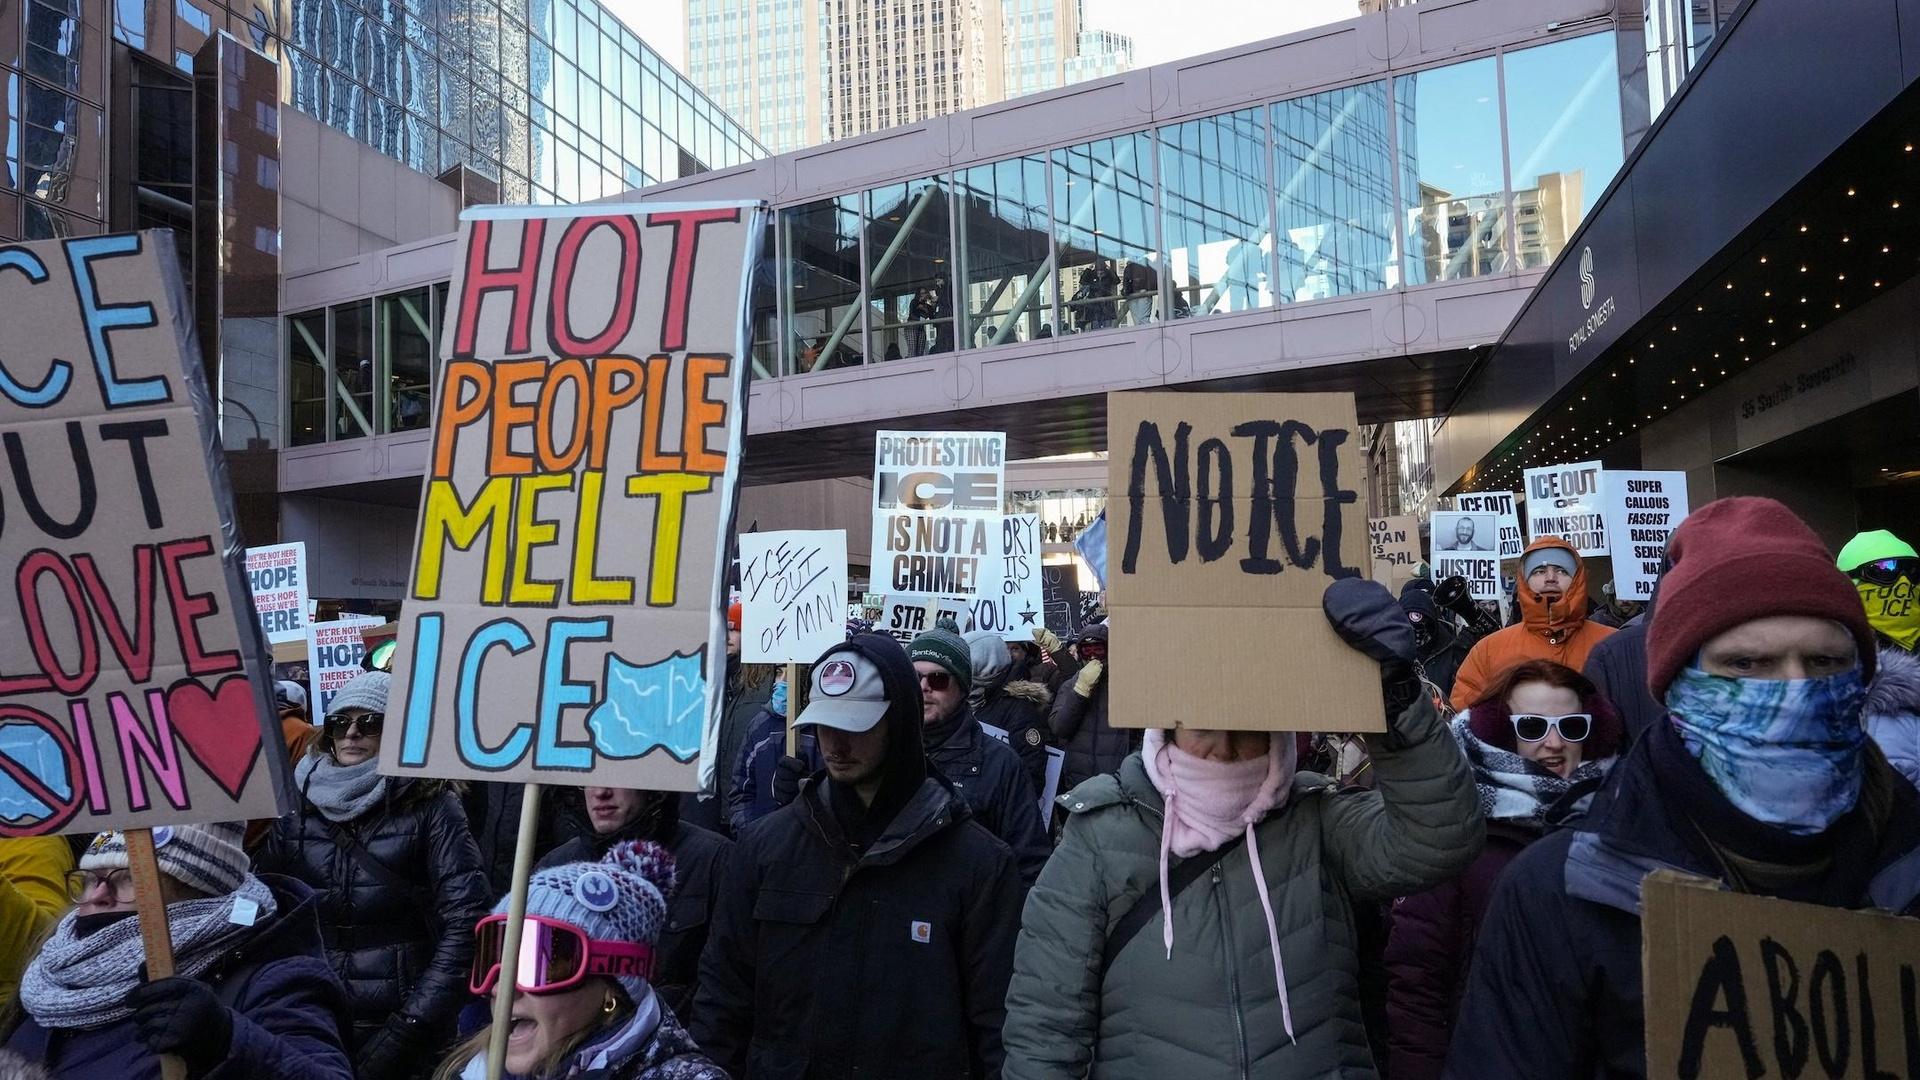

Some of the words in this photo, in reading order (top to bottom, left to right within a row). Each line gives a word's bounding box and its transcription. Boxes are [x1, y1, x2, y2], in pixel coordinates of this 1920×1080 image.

[453, 208, 741, 358] HOT
[1569, 325, 1587, 354] ROYAL
[1587, 296, 1615, 337] SONESTA
[1758, 381, 1793, 412] South
[1797, 352, 1856, 393] Seventh
[431, 353, 732, 480] PEOPLE
[879, 437, 1001, 467] PROTESTING
[0, 419, 168, 539] UT
[1531, 473, 1560, 499] ICE
[1561, 468, 1597, 496] OUT
[1627, 480, 1662, 493] SUPER
[879, 472, 998, 510] ICE
[1460, 497, 1482, 511] ICE
[1484, 495, 1511, 515] OUT
[1554, 498, 1579, 508] OF
[1625, 497, 1669, 509] CALLOUS
[1369, 521, 1387, 532] NO
[1533, 514, 1604, 533] MINNESOTA
[1627, 513, 1670, 525] FASCIST
[412, 471, 713, 608] MELT
[887, 516, 911, 551] IS
[916, 516, 967, 554] NOT
[970, 519, 987, 555] A
[1370, 531, 1406, 544] MAN
[1500, 527, 1519, 539] OTA
[1631, 529, 1670, 542] RACIST
[247, 552, 266, 562] WE'RE
[268, 552, 280, 560] NOT
[281, 549, 297, 558] HERE
[1373, 545, 1384, 554] IS
[1634, 545, 1664, 559] SEXIS
[248, 560, 272, 570] BECAUSE
[274, 557, 297, 566] THERE'S
[743, 541, 791, 602] ICE
[1003, 556, 1030, 579] ITS
[1436, 559, 1495, 579] JUSTICE
[1643, 562, 1661, 574] NAZ
[248, 566, 297, 591] HOPE
[774, 548, 821, 603] OUT
[892, 555, 978, 594] CRIME!
[1003, 580, 1021, 594] ON
[1468, 580, 1495, 594] RETTI
[254, 594, 275, 603] ERE'S
[278, 591, 298, 600] HOPE
[256, 603, 276, 612] CAUSE
[277, 600, 298, 609] WE'RE
[761, 618, 787, 653] OF
[796, 581, 841, 640] MN!
[969, 596, 1014, 631] YOU.
[1880, 599, 1912, 616] ICE
[316, 627, 341, 637] WE'RE
[342, 626, 357, 636] NOT
[316, 636, 348, 646] BECAUSE
[318, 644, 366, 668] HOP
[320, 671, 354, 681] THERE'S
[399, 612, 613, 771] ICE
[68, 688, 191, 815] IN
